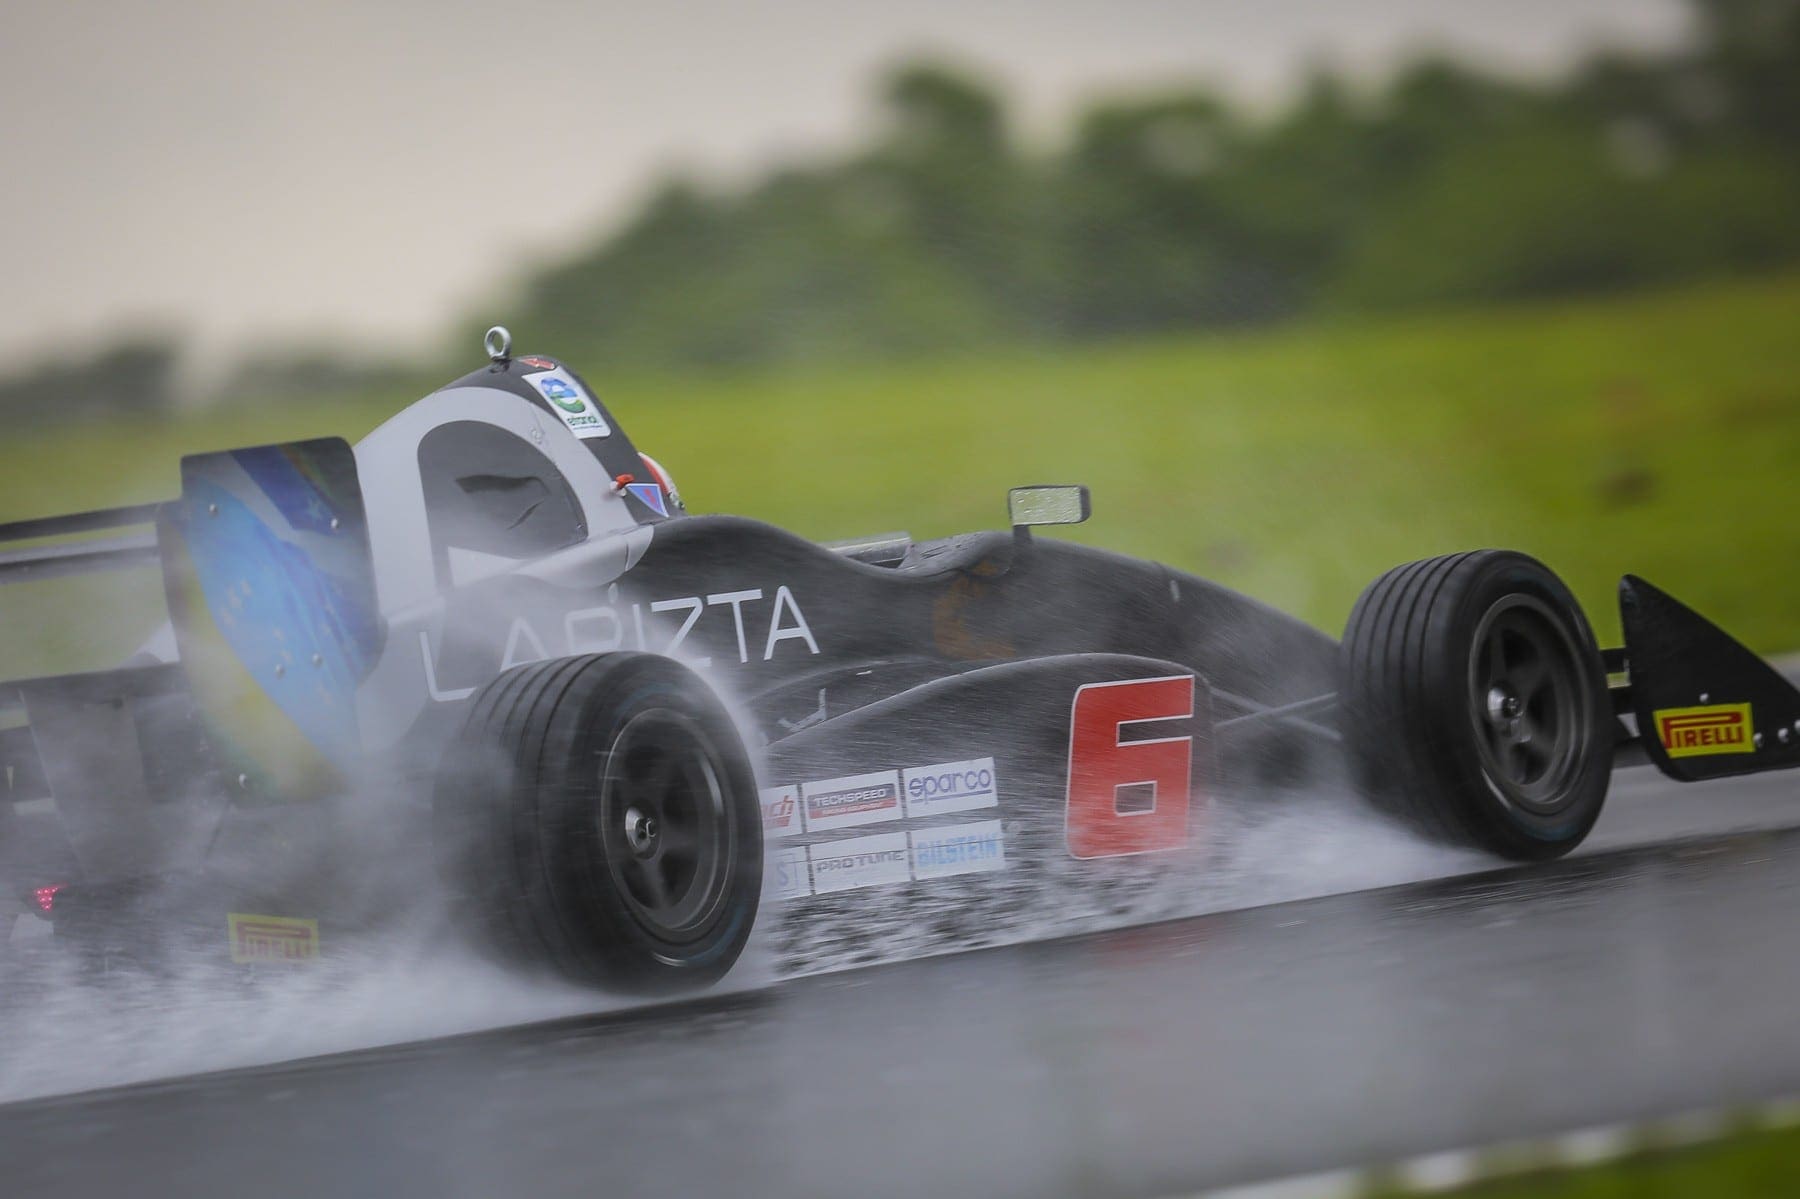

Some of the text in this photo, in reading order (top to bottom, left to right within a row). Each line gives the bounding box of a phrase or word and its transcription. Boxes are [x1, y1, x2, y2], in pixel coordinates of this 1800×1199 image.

[1662, 711, 1744, 750] PIRELLI
[1065, 674, 1194, 859] 6
[814, 788, 887, 807] TECHSPEED
[909, 769, 991, 804] sparco
[917, 832, 999, 868] BILSTEIN
[235, 921, 311, 959] PIRELLI
